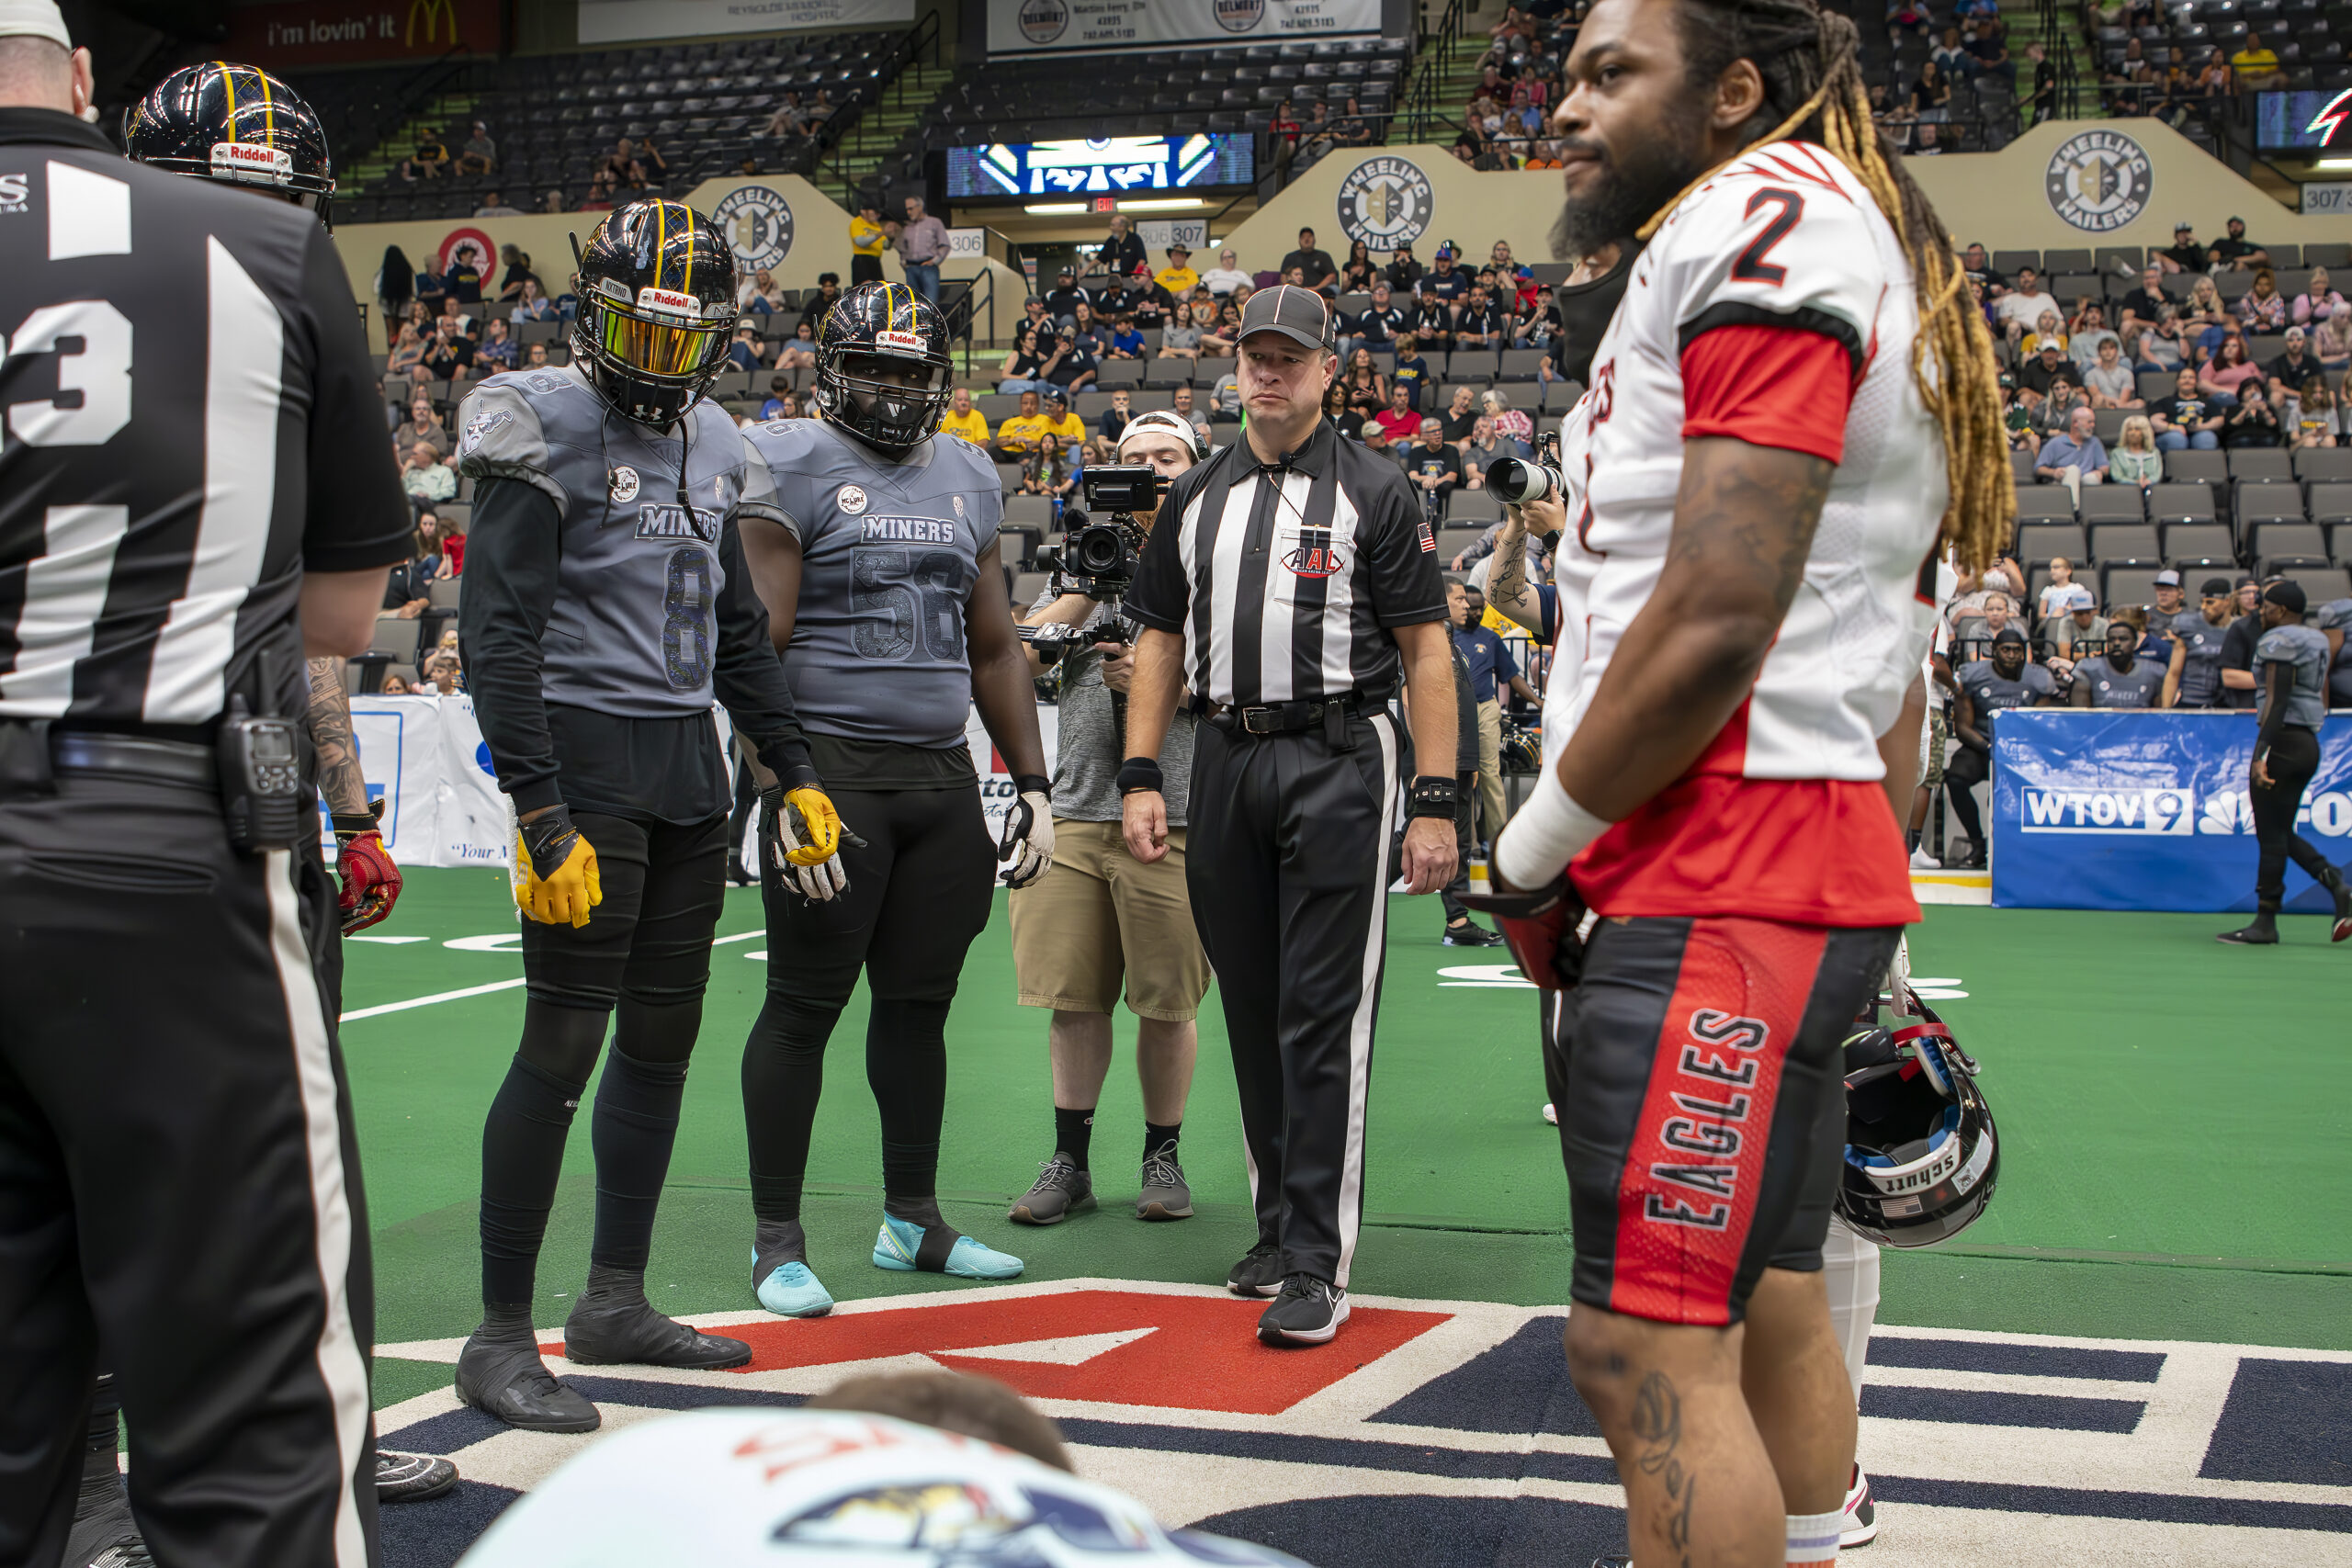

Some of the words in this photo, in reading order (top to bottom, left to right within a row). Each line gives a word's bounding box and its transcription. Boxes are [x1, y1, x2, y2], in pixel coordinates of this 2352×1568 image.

[310, 16, 372, 42] lovin'
[379, 14, 396, 38] it
[231, 146, 274, 163] Riddell
[2050, 133, 2148, 175] WHEELING
[1341, 160, 1429, 198] WHEELING
[714, 189, 791, 225] WHEELING
[1097, 197, 1114, 212] EXIT
[2306, 189, 2342, 209] 307
[2057, 198, 2141, 230] NAILERS
[952, 236, 981, 253] 306
[1139, 228, 1169, 243] 306
[1172, 227, 1203, 243] 307
[1347, 221, 1421, 251] NAILERS
[1730, 186, 1804, 288] 2
[736, 246, 784, 274] ILERS
[605, 280, 627, 299] NXTRND
[653, 292, 689, 308] Riddell
[888, 333, 917, 345] Riddell
[0, 299, 133, 453] 3
[614, 481, 637, 490] CLURE
[866, 518, 955, 543] MINERS
[1290, 547, 1337, 570] AAL
[662, 545, 716, 687] 8
[978, 777, 1017, 797] to
[1644, 1008, 1770, 1233] EAGLES
